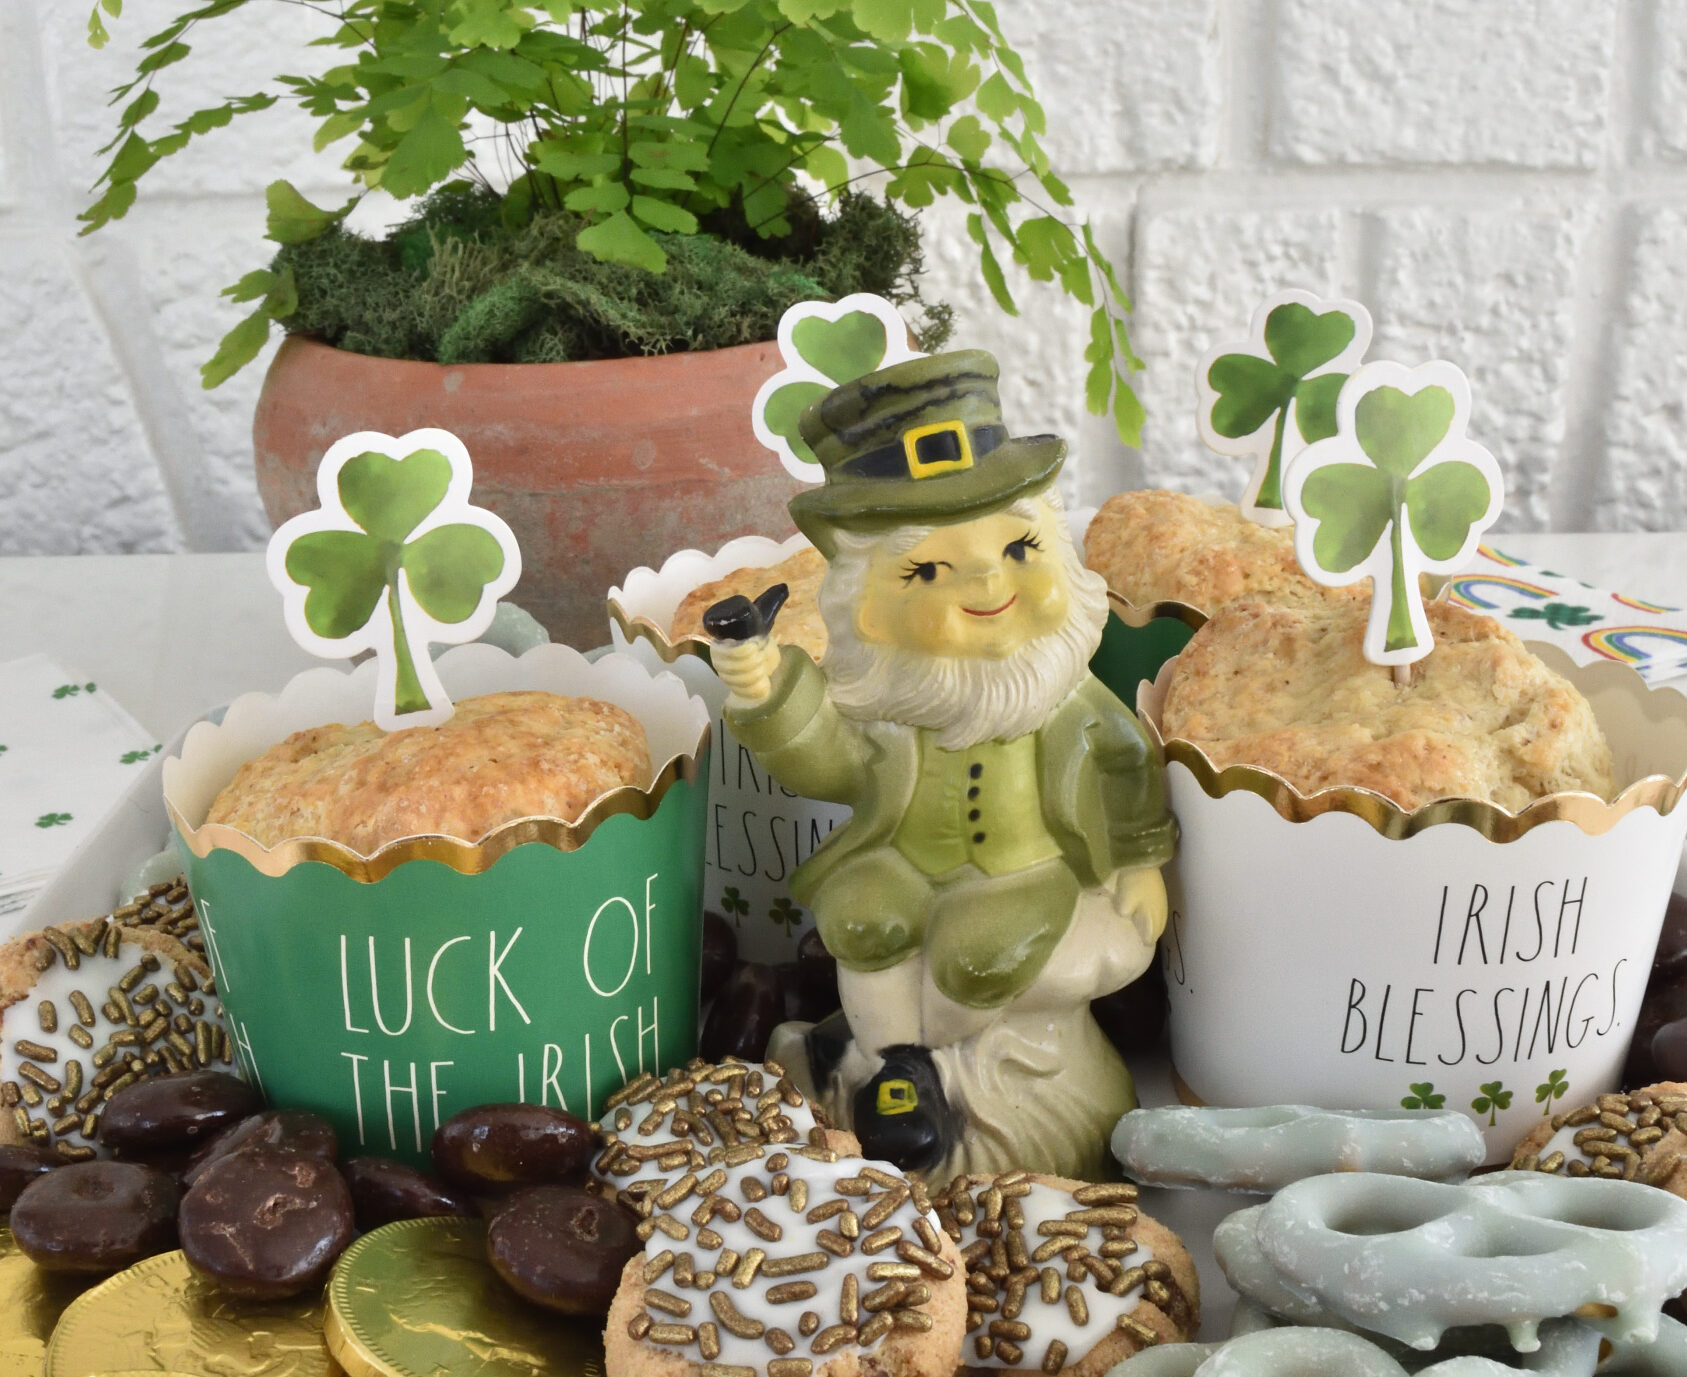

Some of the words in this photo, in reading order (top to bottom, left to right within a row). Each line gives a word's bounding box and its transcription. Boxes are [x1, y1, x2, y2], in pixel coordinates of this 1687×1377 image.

[340, 926, 531, 1036] LUCK
[583, 872, 659, 997] OF
[1433, 876, 1589, 966] IRISH
[518, 995, 660, 1122] IRISH
[1340, 957, 1628, 1066] BLESSINGS.
